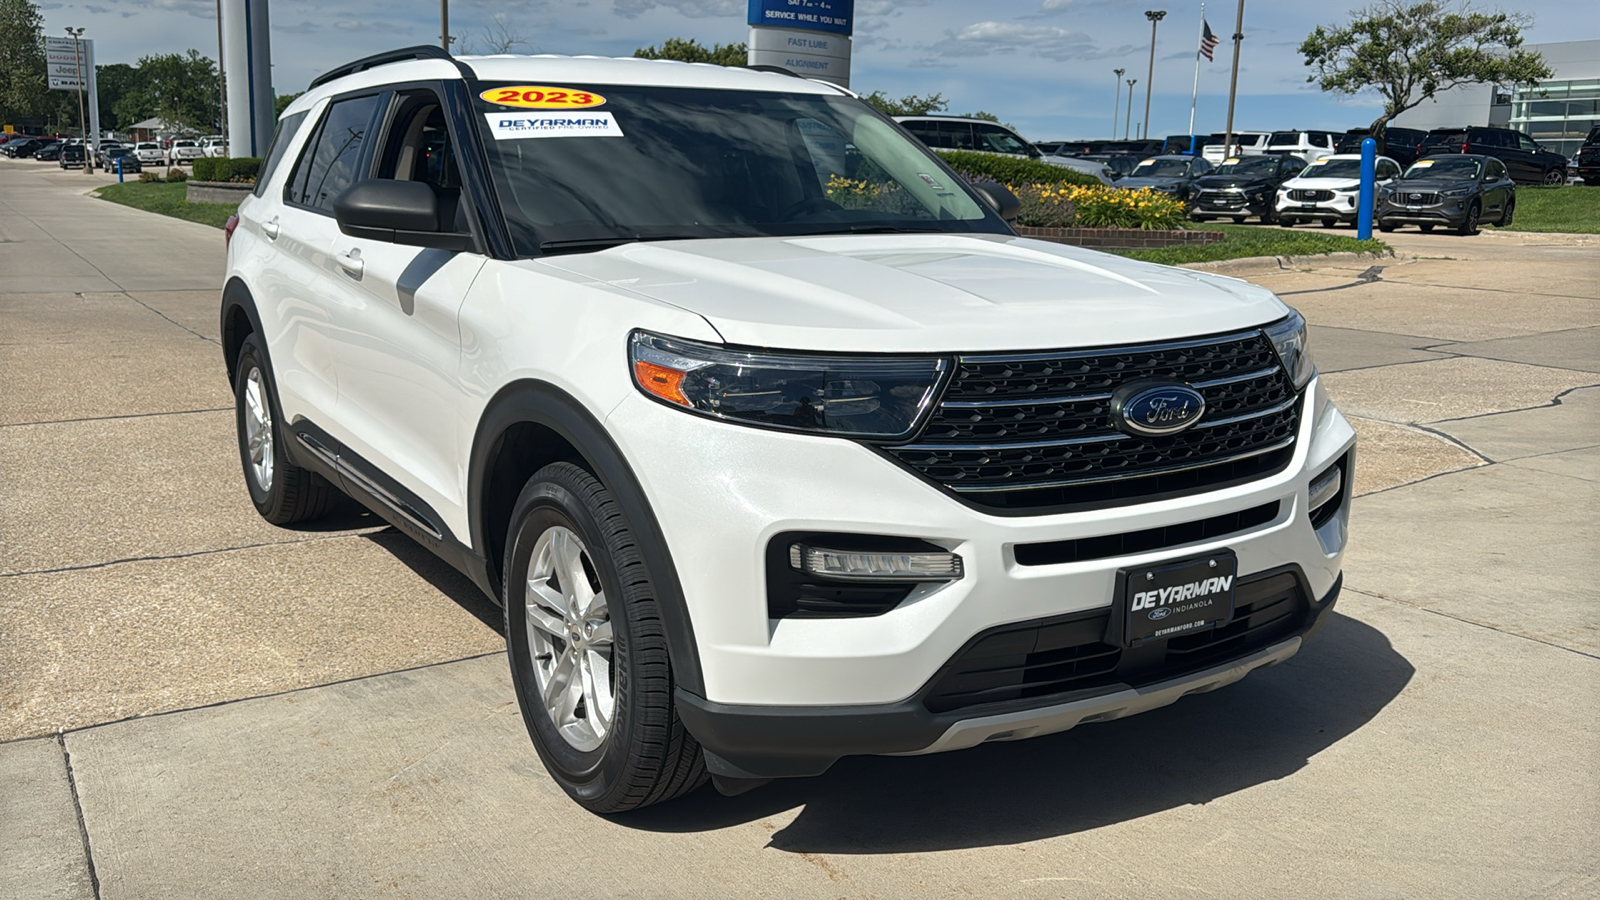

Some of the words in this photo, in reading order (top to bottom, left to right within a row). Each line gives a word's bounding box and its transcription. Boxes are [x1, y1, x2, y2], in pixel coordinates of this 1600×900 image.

[765, 10, 795, 19] SERVICE
[798, 13, 818, 22] WHILE
[819, 15, 832, 24] YOU
[834, 17, 847, 26] WAIT
[787, 37, 807, 46] FAST
[809, 39, 828, 49] LUBE
[55, 66, 78, 75] Jeep
[785, 59, 829, 70] ALIGNMENT
[496, 91, 594, 104] 2023
[499, 119, 608, 128] DEYARMAN
[1146, 396, 1189, 423] Ford
[1131, 575, 1233, 612] DEYARMAN
[1172, 599, 1213, 614] INDIANOLA
[1155, 620, 1205, 637] DEYARMANFORD.COM
